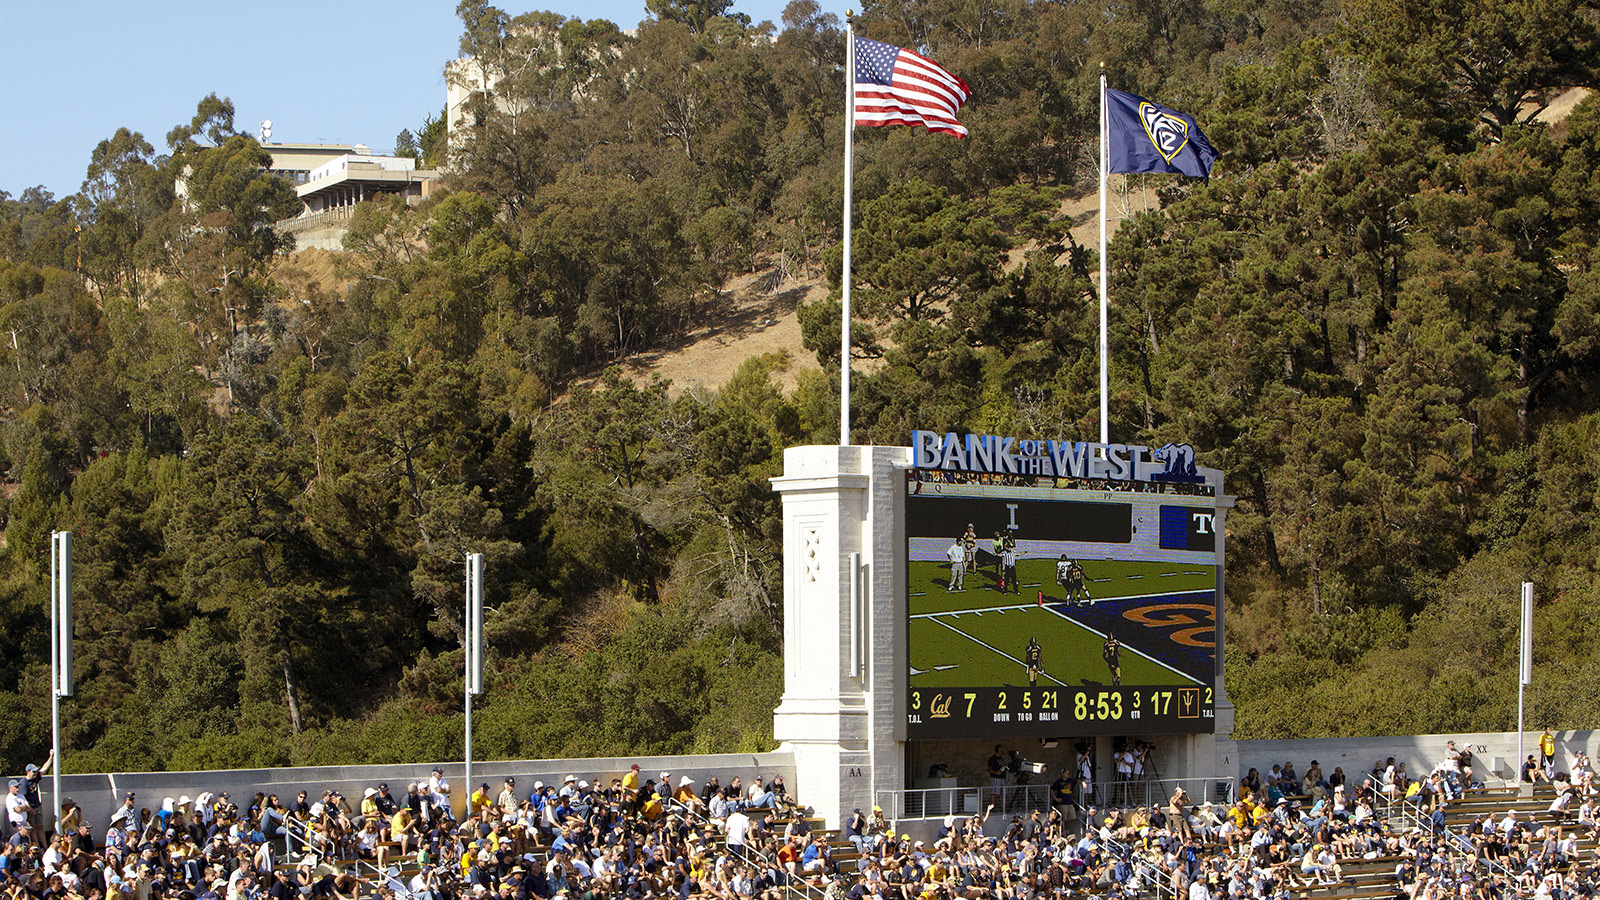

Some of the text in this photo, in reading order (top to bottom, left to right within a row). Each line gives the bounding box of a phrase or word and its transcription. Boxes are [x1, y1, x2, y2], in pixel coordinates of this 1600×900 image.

[912, 430, 1148, 480] BANK OF THE WEST
[1006, 504, 1018, 530] I
[1193, 513, 1216, 534] T
[912, 691, 921, 710] 3
[998, 691, 1007, 709] 2
[1023, 691, 1031, 709] 5
[1042, 691, 1057, 709] 21
[1133, 691, 1141, 708] 3
[1151, 691, 1173, 715] 17
[1204, 687, 1213, 704] 2
[930, 693, 952, 719] Cal
[964, 693, 977, 718] 7
[1074, 692, 1123, 721] 8:53
[1130, 710, 1141, 719] QTR
[993, 713, 1010, 722] DOWN
[1018, 713, 1033, 722] TO GO
[1039, 712, 1059, 721] BALL ON
[1476, 745, 1488, 753] XX
[1224, 756, 1230, 764] A
[849, 768, 862, 777] AA
